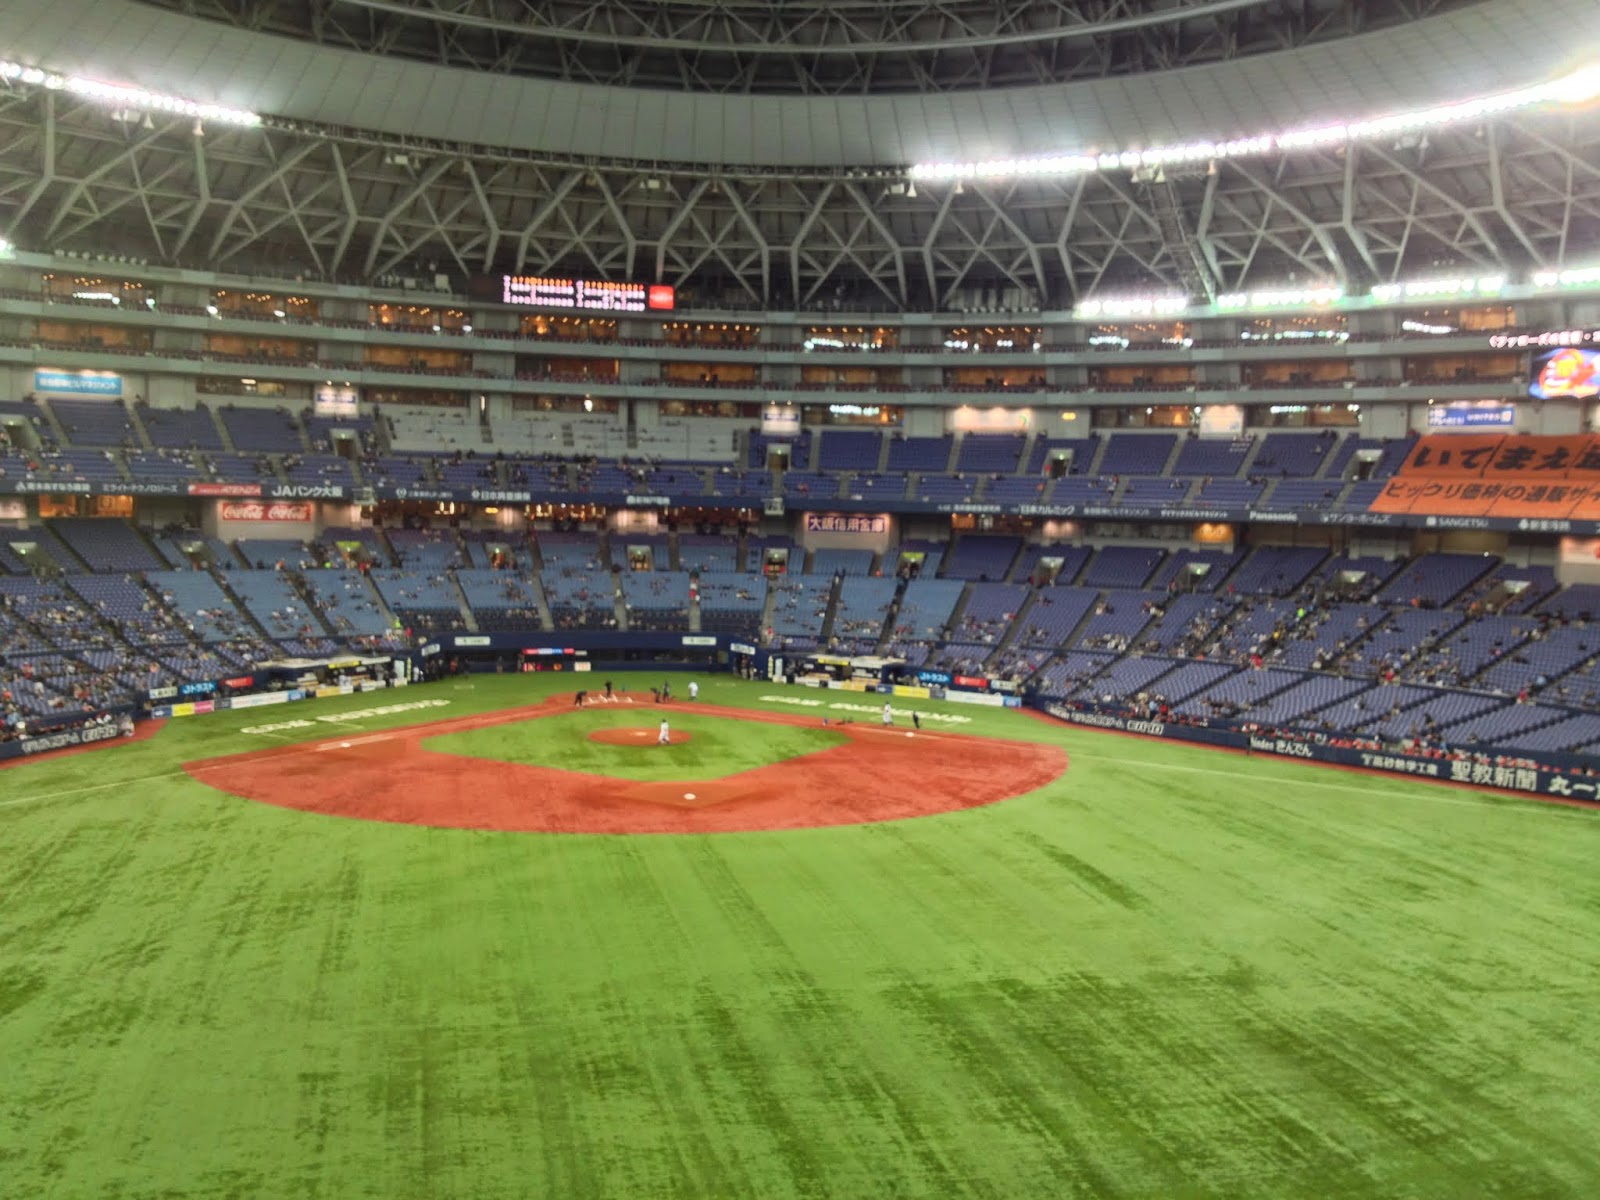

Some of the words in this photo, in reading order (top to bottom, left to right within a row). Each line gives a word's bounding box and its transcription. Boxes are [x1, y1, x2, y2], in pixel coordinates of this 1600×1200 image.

[272, 485, 343, 498] JAバンク大阪
[1250, 511, 1297, 522] Panasonic
[809, 517, 884, 533] 大阪信用金庫
[1276, 739, 1313, 758] きんでん
[1451, 760, 1538, 792] 聖教新聞
